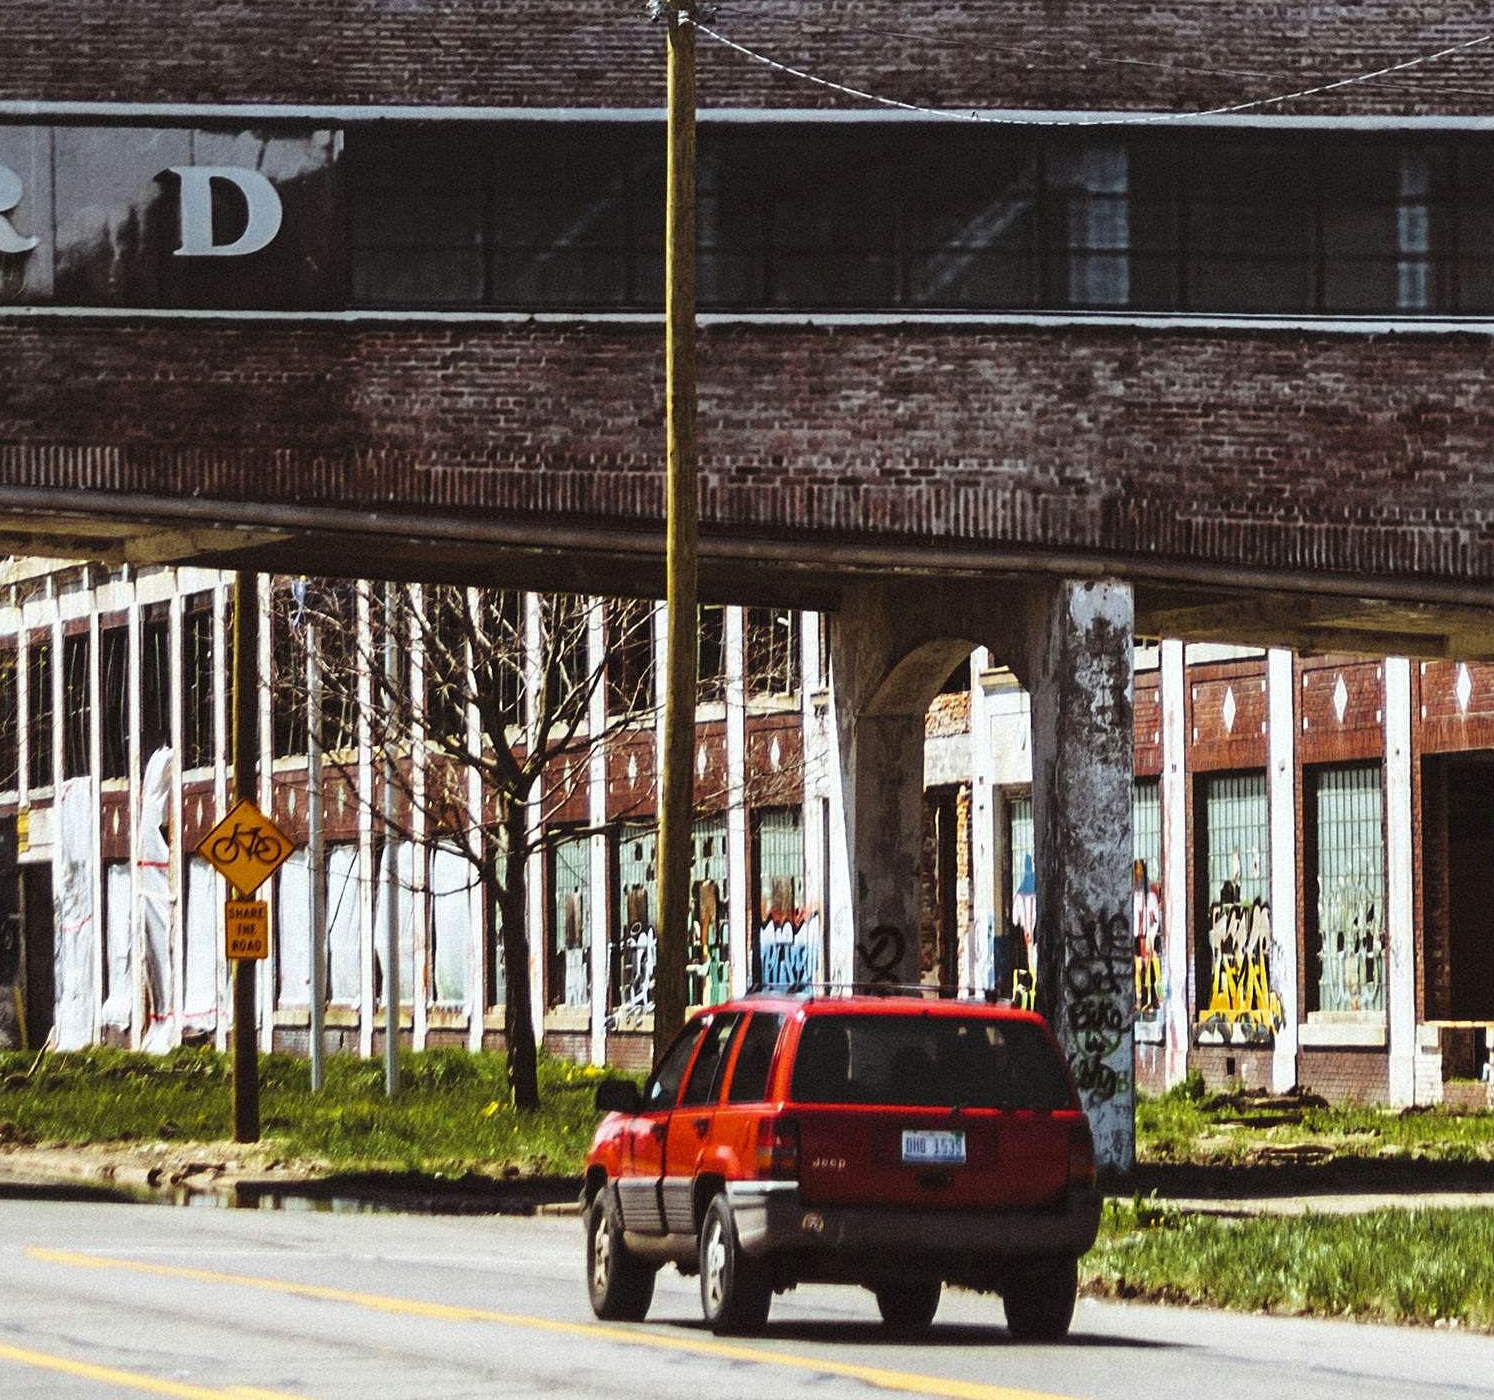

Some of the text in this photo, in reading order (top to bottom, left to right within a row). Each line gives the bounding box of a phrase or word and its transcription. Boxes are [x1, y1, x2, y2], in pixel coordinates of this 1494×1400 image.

[228, 907, 265, 919] SHARE
[236, 923, 257, 935] THE
[231, 939, 263, 952] ROAD
[812, 1156, 847, 1172] Jeep
